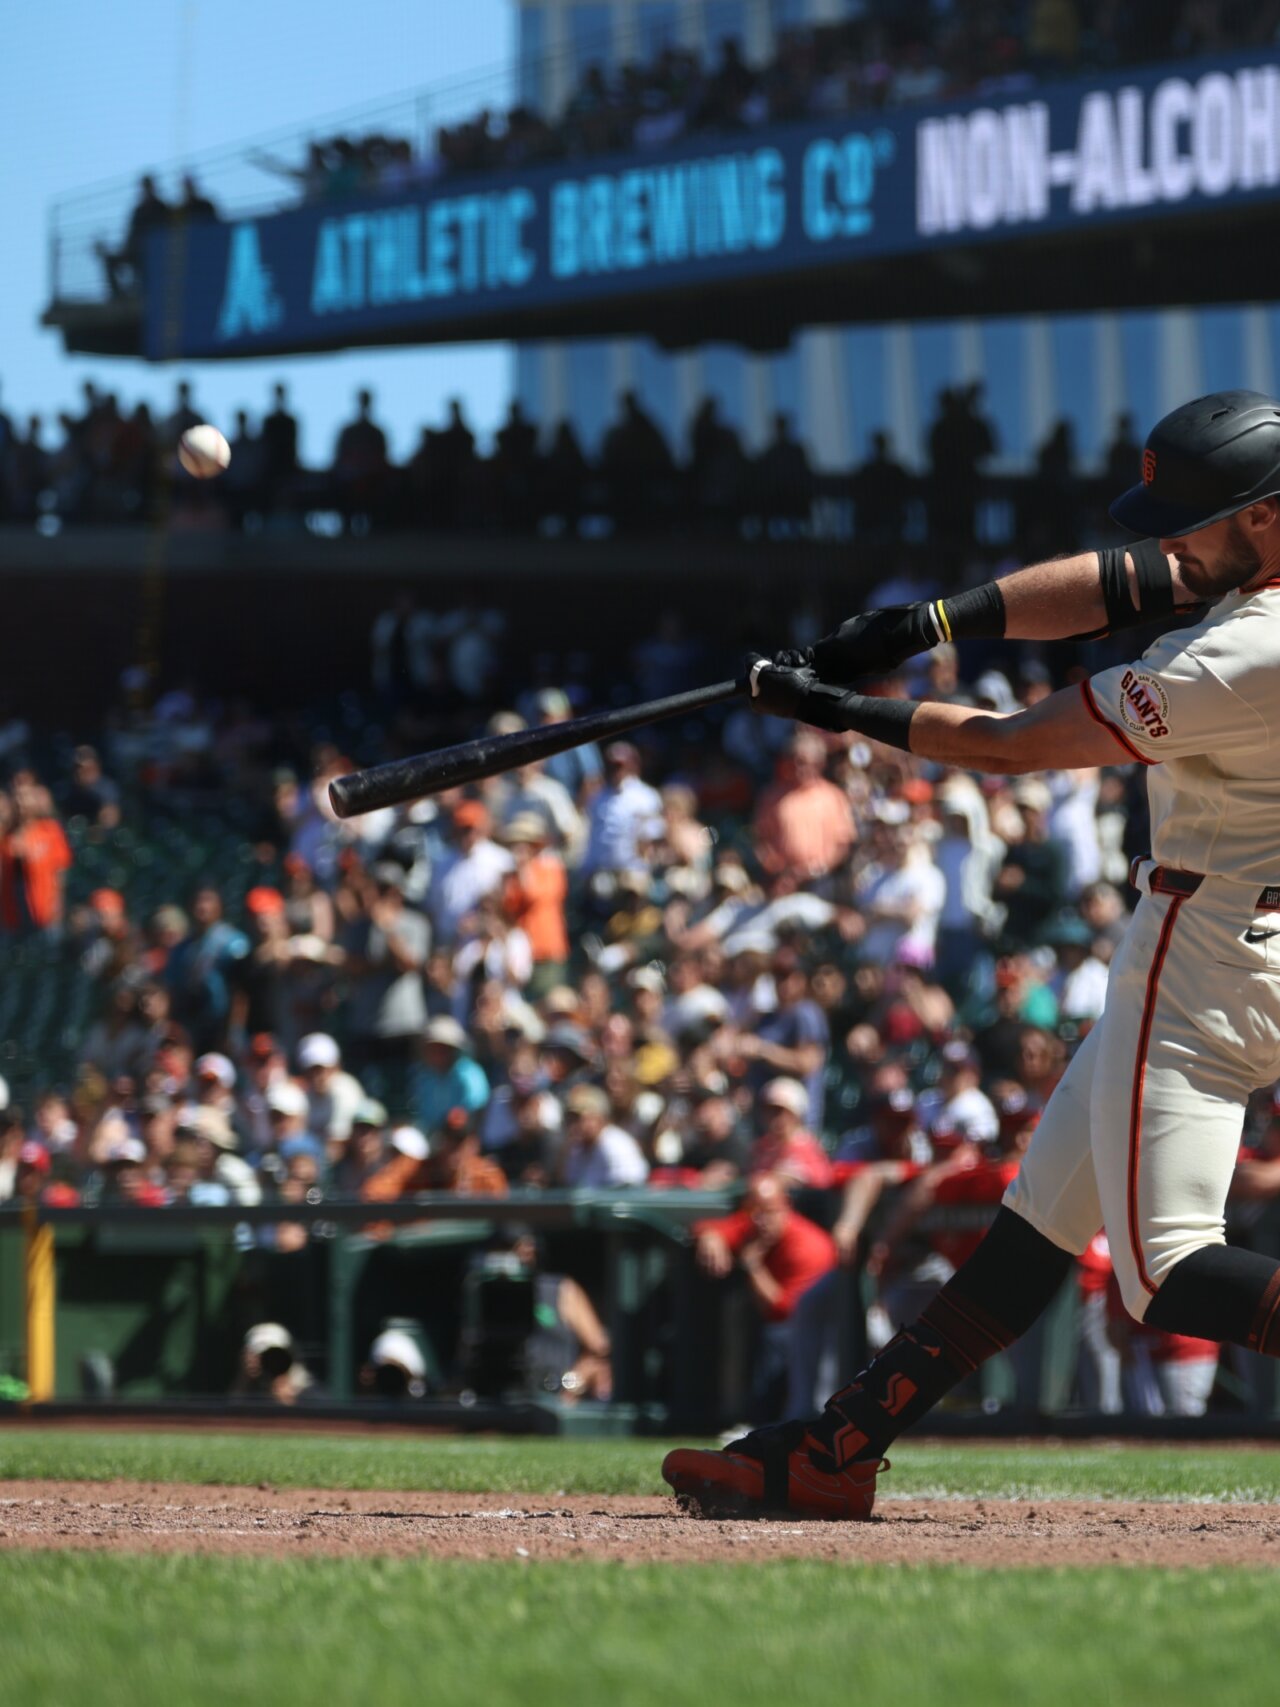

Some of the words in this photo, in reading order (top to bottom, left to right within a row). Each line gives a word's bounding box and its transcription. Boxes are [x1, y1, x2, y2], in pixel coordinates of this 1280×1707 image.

[311, 187, 537, 314] ATHLETIC
[549, 148, 786, 279] BREWING
[1121, 670, 1169, 738] GIANTS
